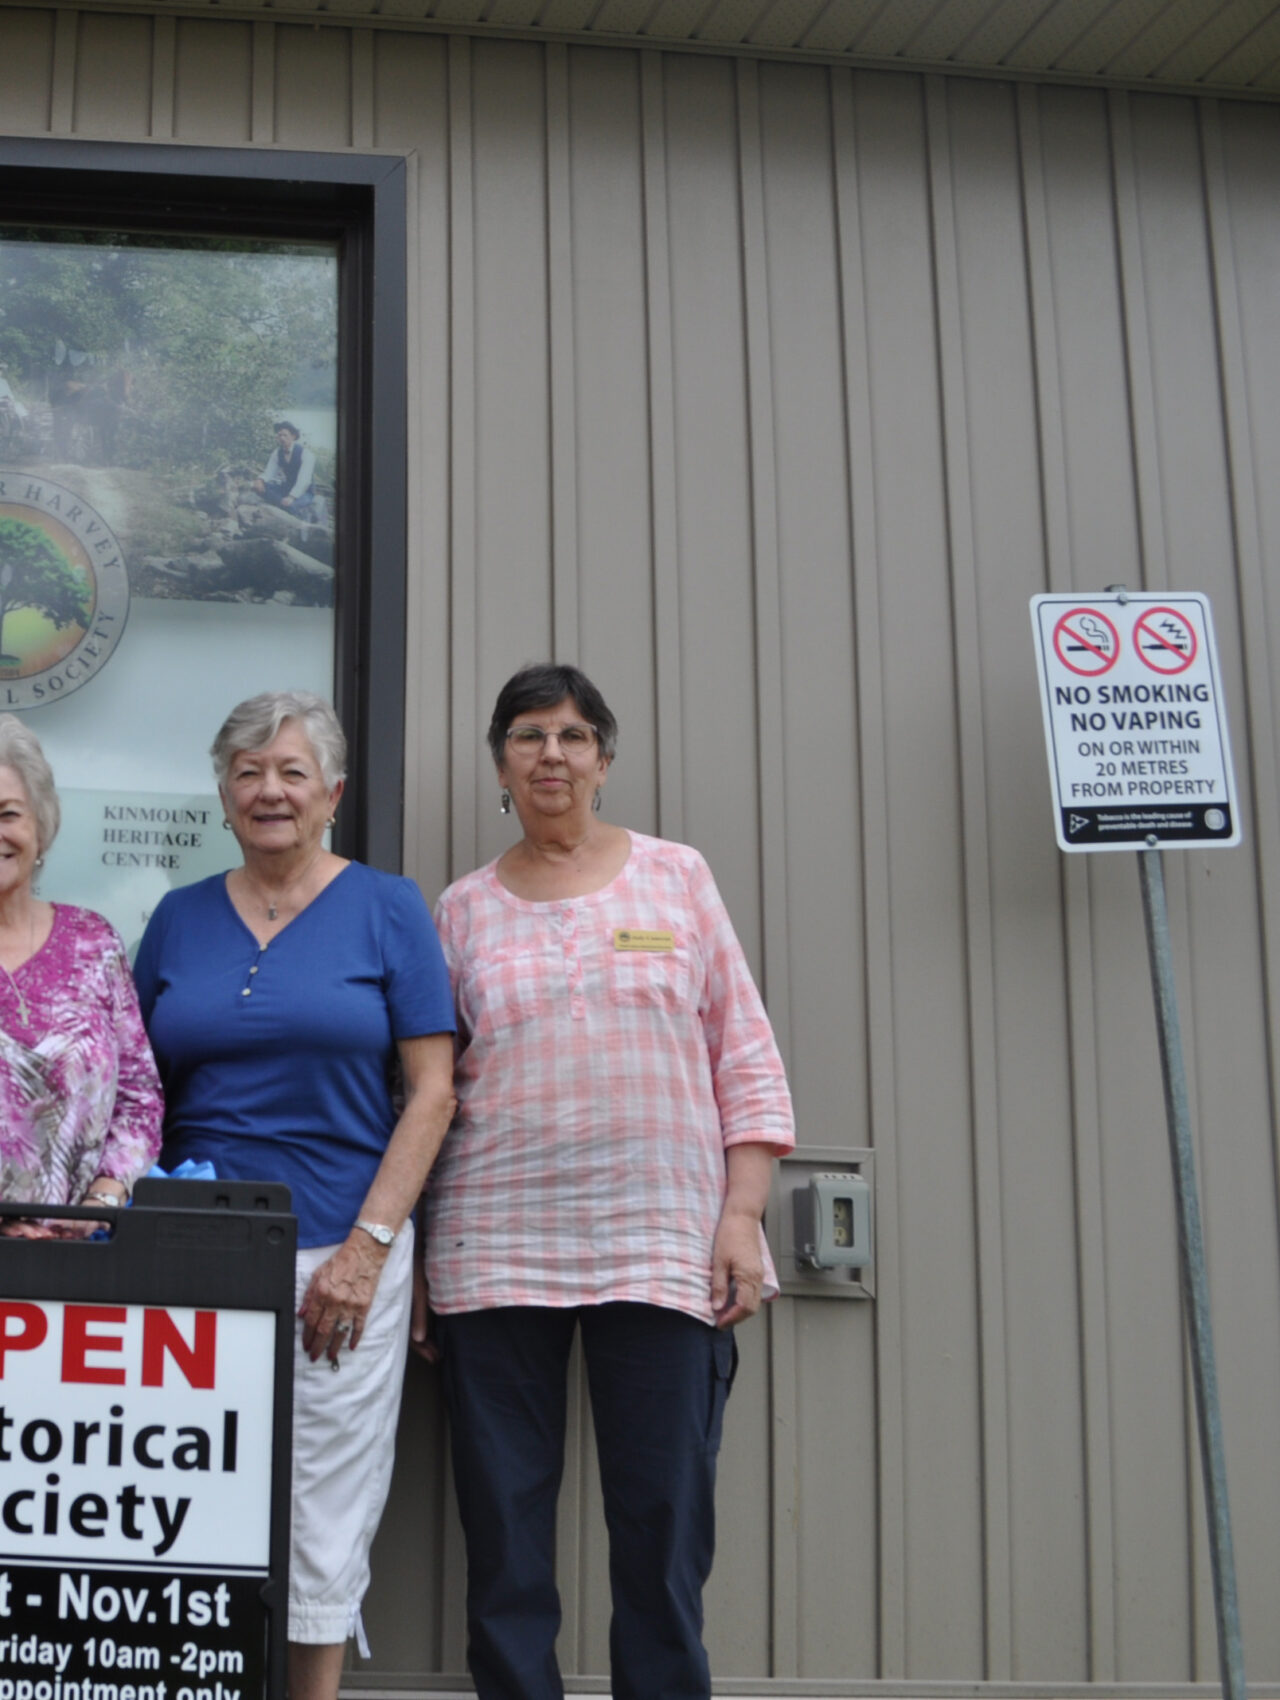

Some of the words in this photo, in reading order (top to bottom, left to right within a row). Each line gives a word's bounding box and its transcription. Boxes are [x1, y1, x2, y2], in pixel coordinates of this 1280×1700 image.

[25, 483, 121, 569] HARVEY
[32, 610, 116, 699] SOCIETY
[1055, 686, 1091, 705] NO
[1097, 683, 1210, 704] SMOKING
[1071, 712, 1107, 732] NO
[1111, 710, 1202, 731] VAPING
[1078, 742, 1105, 757] ON
[1109, 741, 1135, 756] OR
[1137, 739, 1201, 755] WITHIN
[1096, 762, 1117, 777] 20
[1121, 760, 1189, 776] METRES
[1071, 782, 1124, 798] FROM
[1127, 779, 1216, 796] PROPERTY
[104, 805, 211, 825] KINMOUNT
[103, 828, 202, 848] HERITAGE
[101, 851, 181, 869] CENTRE
[58, 1572, 231, 1627] Nov.1st
[83, 1638, 160, 1671] 10am
[169, 1643, 244, 1679] -2pm
